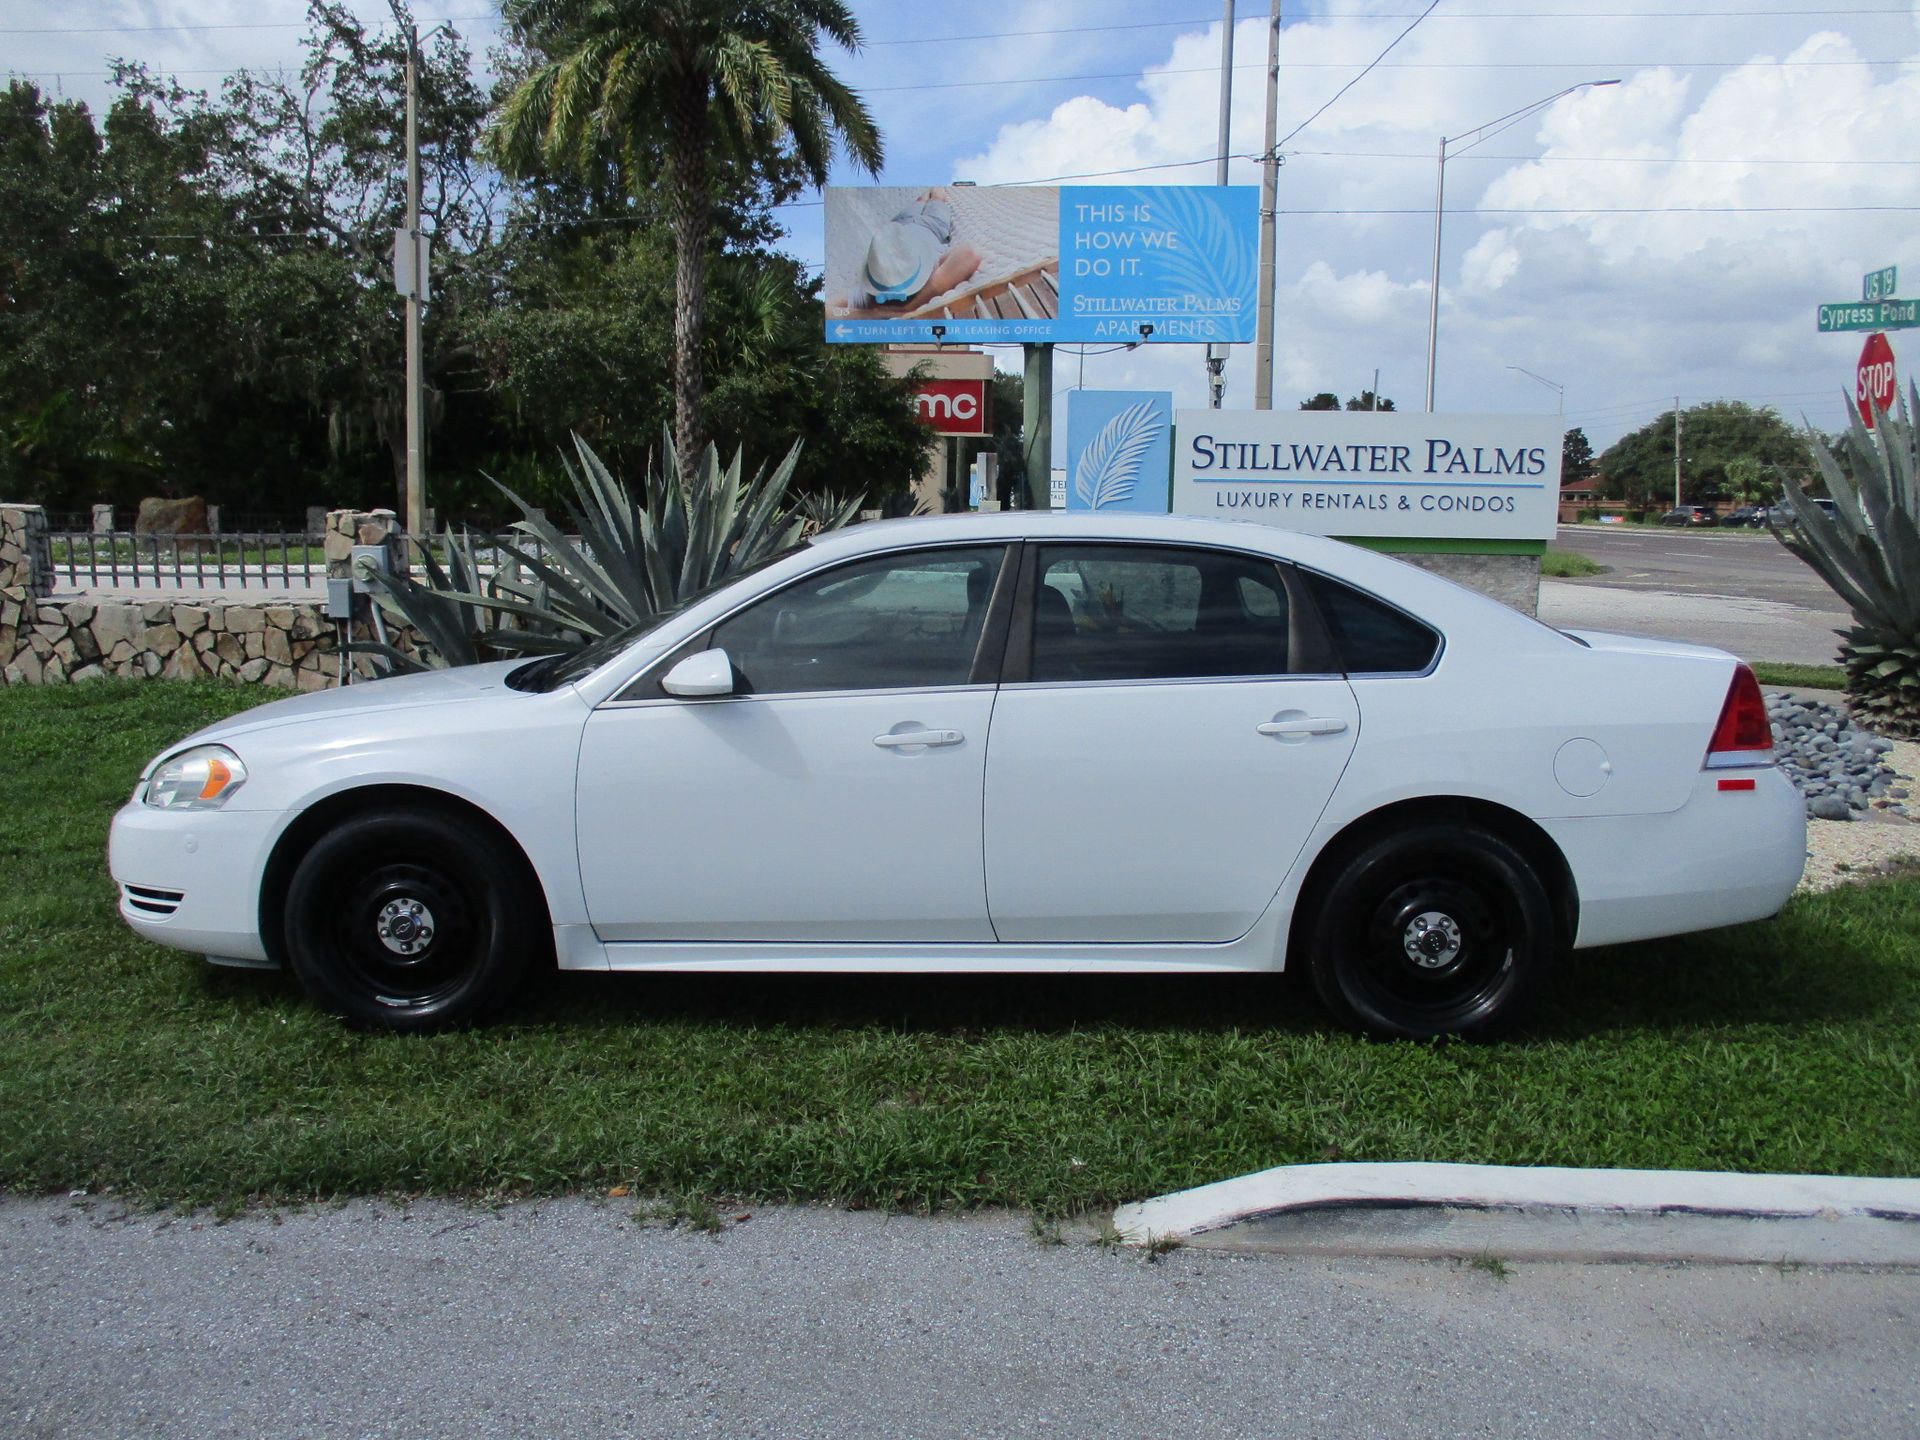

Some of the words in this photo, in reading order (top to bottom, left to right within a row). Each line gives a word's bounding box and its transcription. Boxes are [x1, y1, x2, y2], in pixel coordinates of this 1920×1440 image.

[1075, 204, 1125, 223] THIS
[1134, 204, 1151, 223] IS
[1075, 231, 1135, 250] HOW
[1141, 231, 1178, 250] WE
[1075, 258, 1111, 277] DO
[1120, 258, 1143, 277] IT.
[1866, 274, 1879, 299] US
[1073, 294, 1177, 313] STILLWATER
[1183, 294, 1241, 313] PALMS
[1819, 306, 1875, 330] Cypress
[1881, 302, 1916, 322] Pond
[858, 327, 887, 336] TURN
[892, 327, 915, 336] LEFT
[942, 327, 961, 336] UR
[965, 326, 1010, 336] LEASING
[1014, 326, 1052, 336] OFFICE
[1094, 320, 1216, 336] APARMENTS
[1858, 361, 1893, 401] STOP
[1191, 435, 1412, 473] STILLWATER
[1423, 439, 1546, 476] PALMS
[1216, 491, 1293, 508] LUXURY
[1302, 493, 1388, 511] RENTALS
[1397, 495, 1411, 511] &
[1420, 494, 1516, 513] CONDOS
